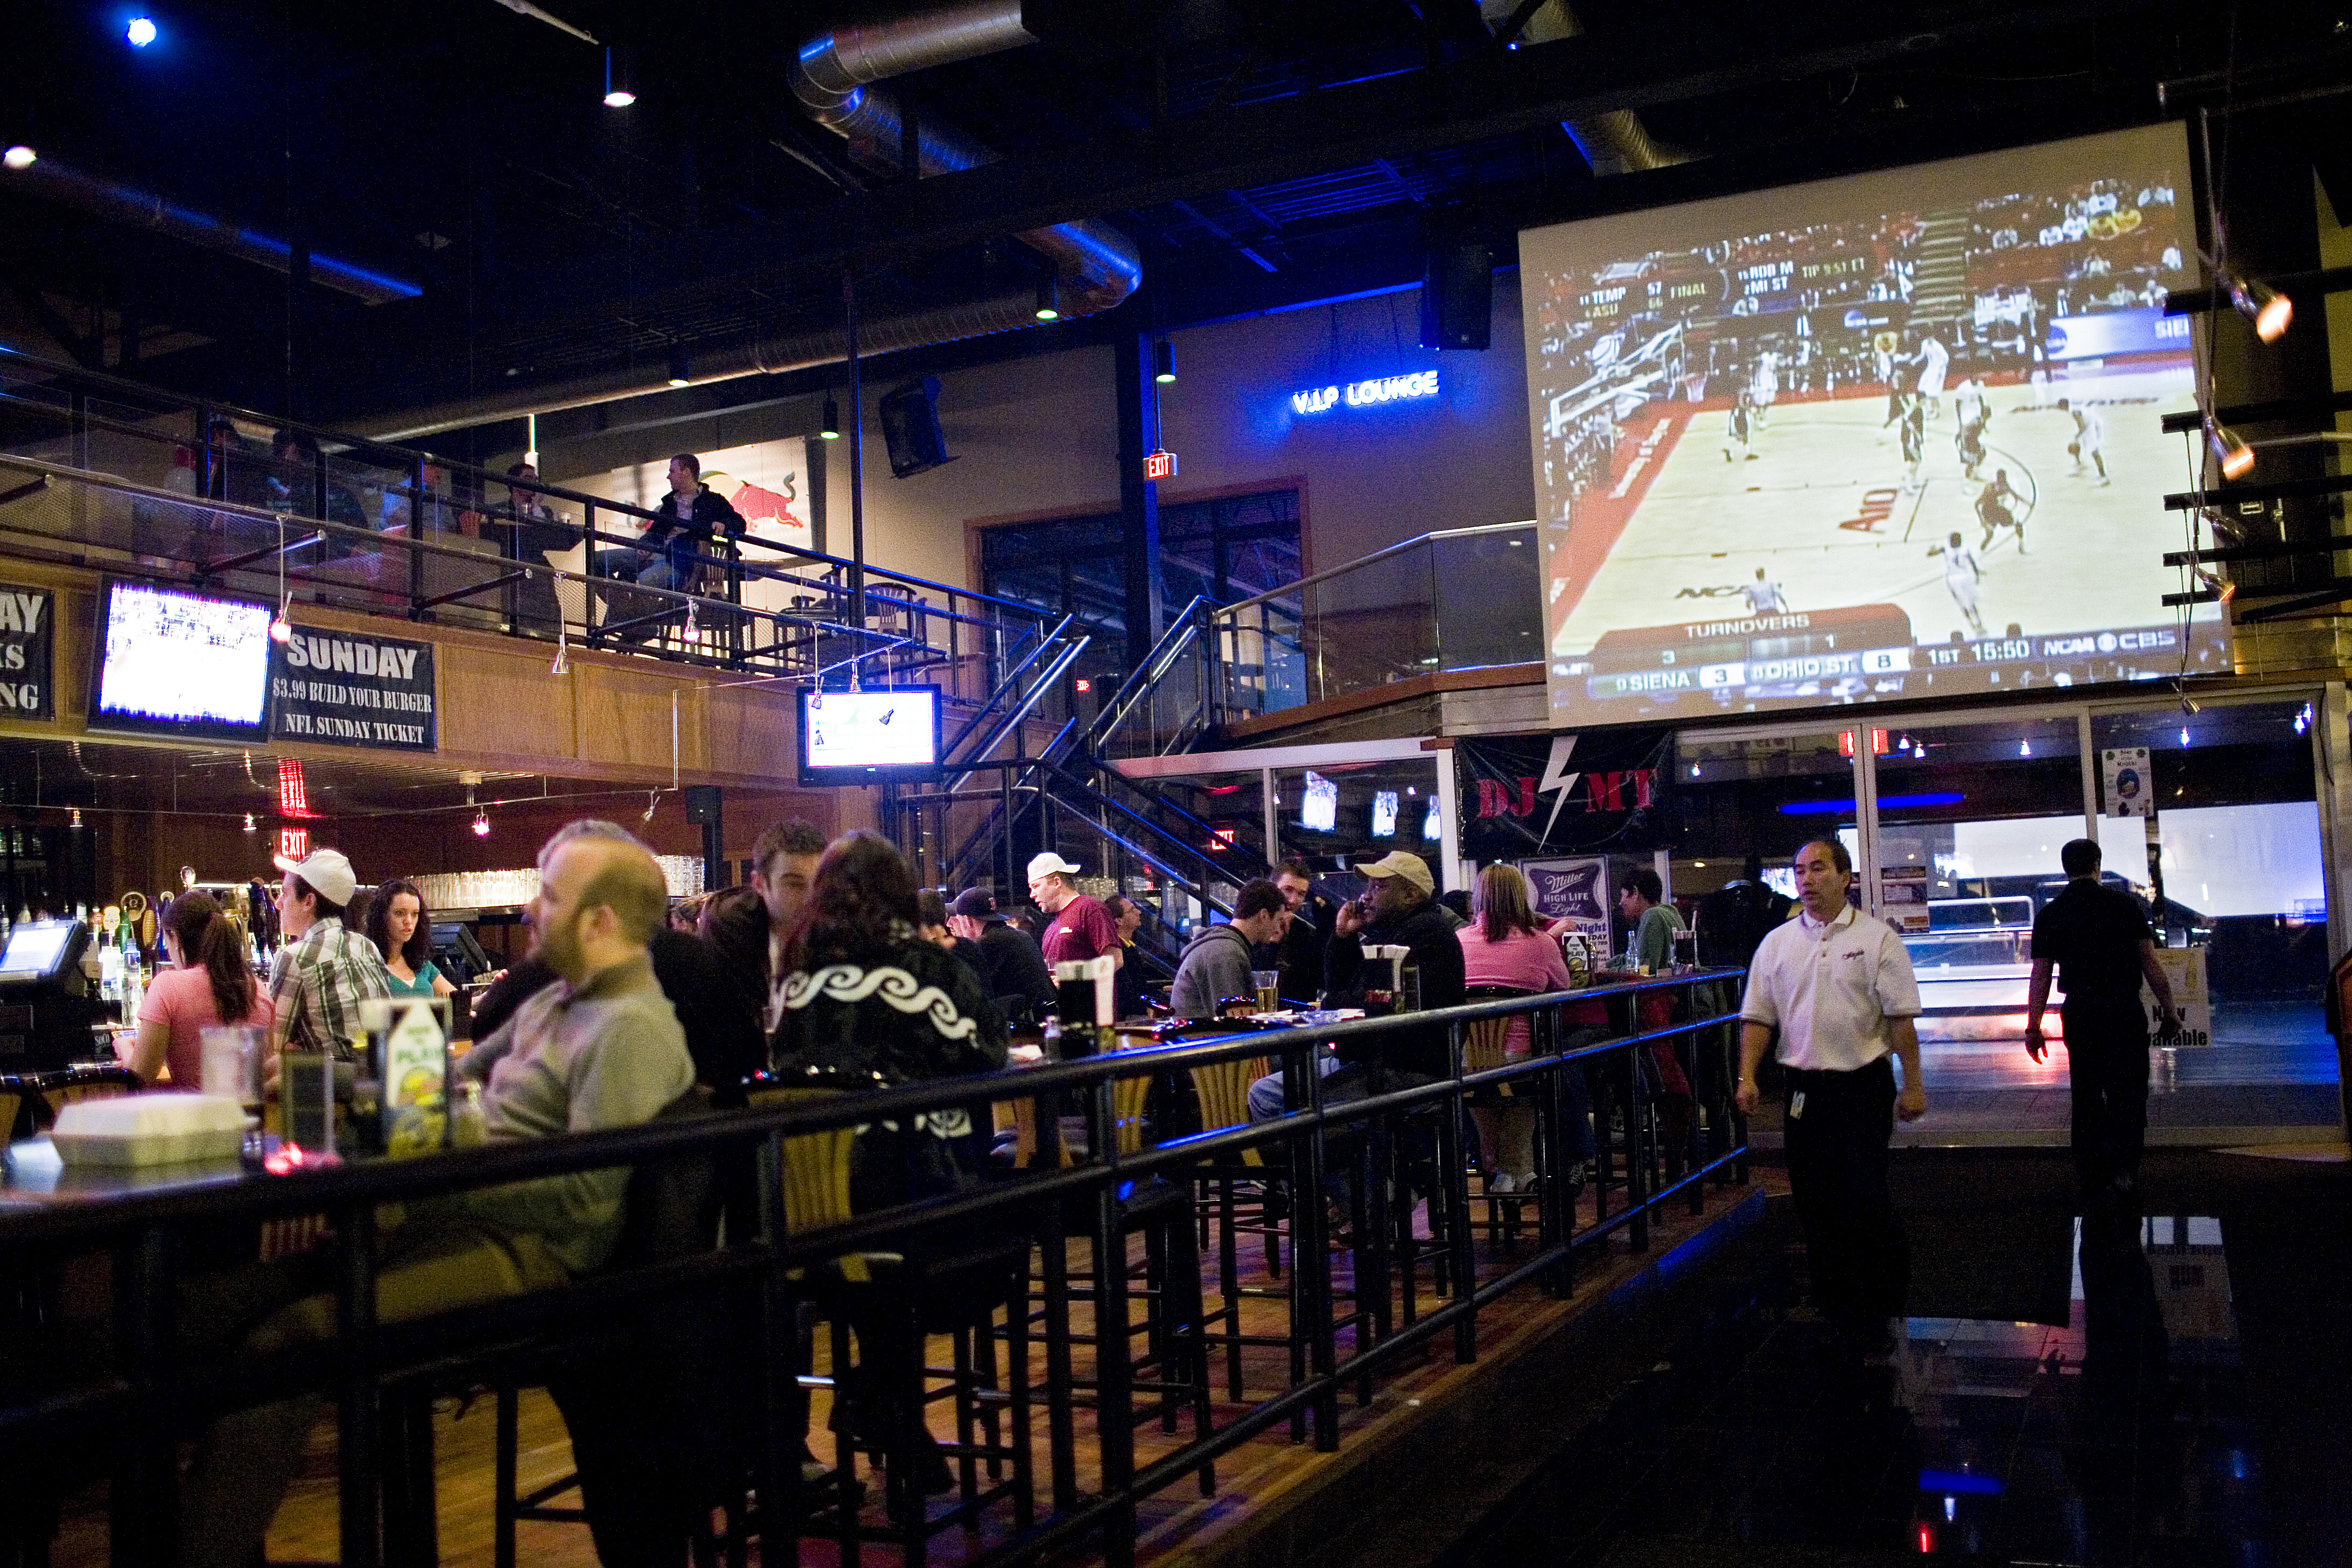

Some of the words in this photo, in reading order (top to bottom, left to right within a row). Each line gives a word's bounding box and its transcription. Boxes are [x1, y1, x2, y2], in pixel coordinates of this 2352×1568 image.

[1592, 286, 1626, 304] TEMP
[1671, 283, 1705, 299] FINAL
[1347, 370, 1439, 406] LOUNGE
[1148, 455, 1170, 478] EXIT
[1685, 614, 1810, 638] TURNOVERS
[287, 633, 417, 680] SUNDAY
[1662, 650, 1675, 664] 3
[1766, 659, 1820, 678] OHIO
[1826, 654, 1852, 674] ST
[1878, 654, 1891, 668] 8
[2119, 630, 2175, 648] CBS
[1630, 671, 1690, 690] SIENA
[1715, 668, 1727, 683] 3
[273, 677, 306, 700] $3.99
[309, 682, 346, 704] BUILD
[349, 687, 381, 709] YOUR
[383, 691, 432, 713] BURGER
[285, 713, 314, 734] NFL
[317, 717, 370, 739] SUNDAY
[374, 722, 424, 744] TICKET
[1476, 776, 1536, 818] DJ
[1585, 769, 1657, 813] MT
[281, 831, 307, 856] EXIT
[1544, 873, 1585, 891] Miller
[1544, 894, 1566, 902] HIGH
[1569, 892, 1588, 901] LIFE
[1550, 903, 1581, 916] Light
[1576, 923, 1607, 935] Night
